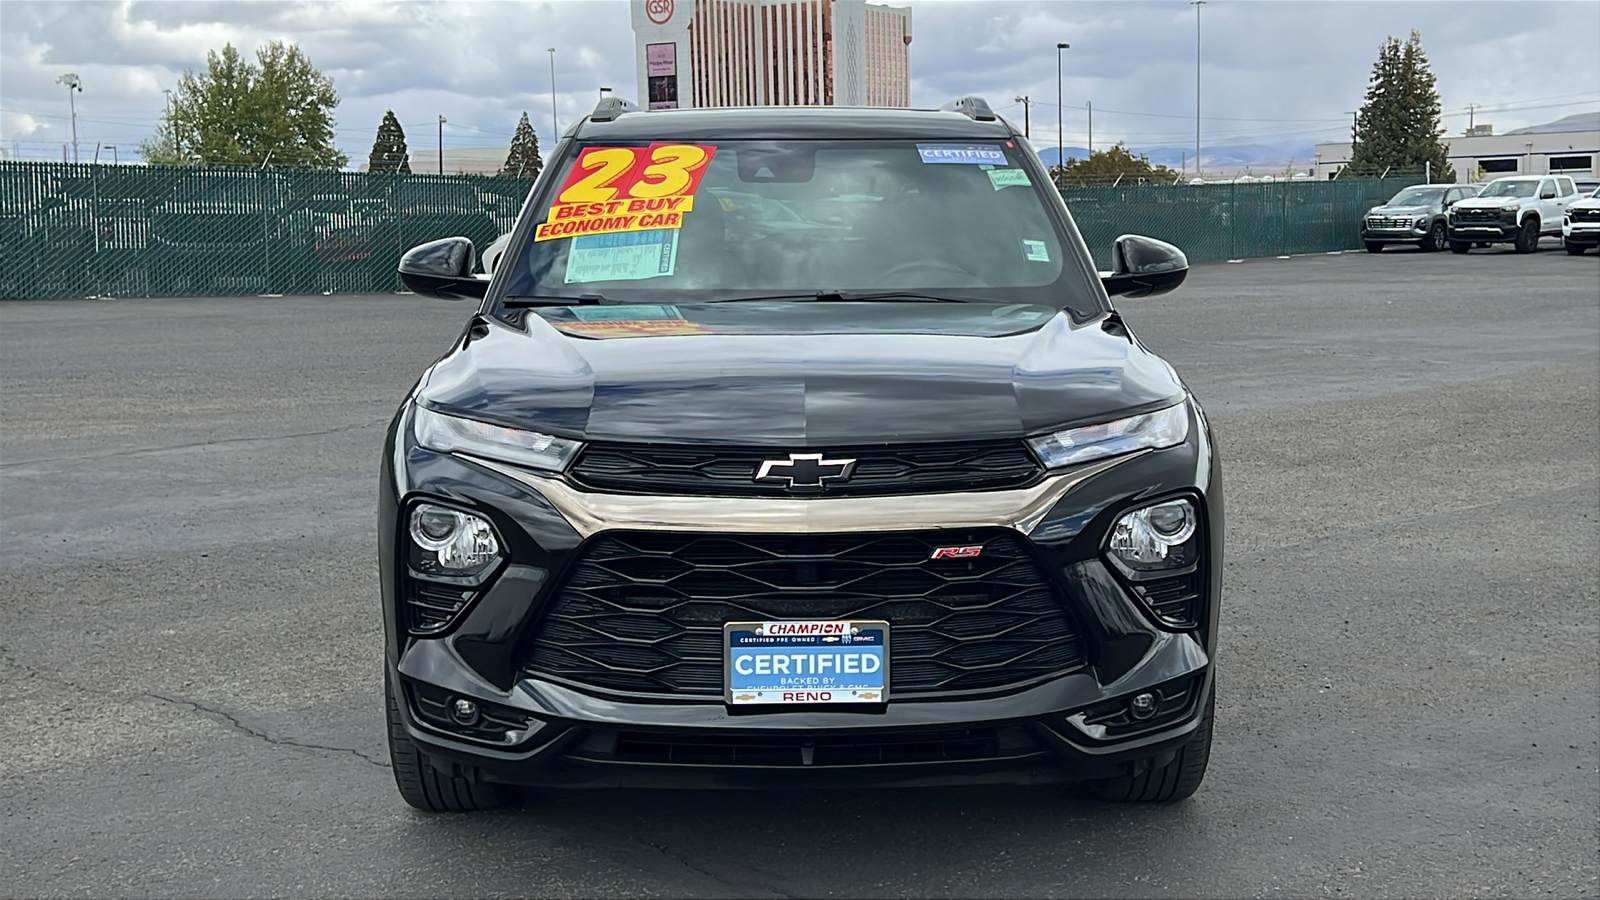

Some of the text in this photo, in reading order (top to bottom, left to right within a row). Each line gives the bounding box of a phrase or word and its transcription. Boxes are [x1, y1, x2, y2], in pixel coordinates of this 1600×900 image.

[649, 0, 670, 14] GSR
[924, 149, 1000, 159] CERTIFIED
[555, 197, 685, 220] BEST BUY
[537, 212, 681, 238] ECONOMY CAR
[930, 546, 983, 559] RS
[769, 623, 844, 635] CHAMPION
[734, 653, 881, 675] CERTIFIED
[780, 677, 819, 685] BACKED
[783, 692, 832, 702] RENO
